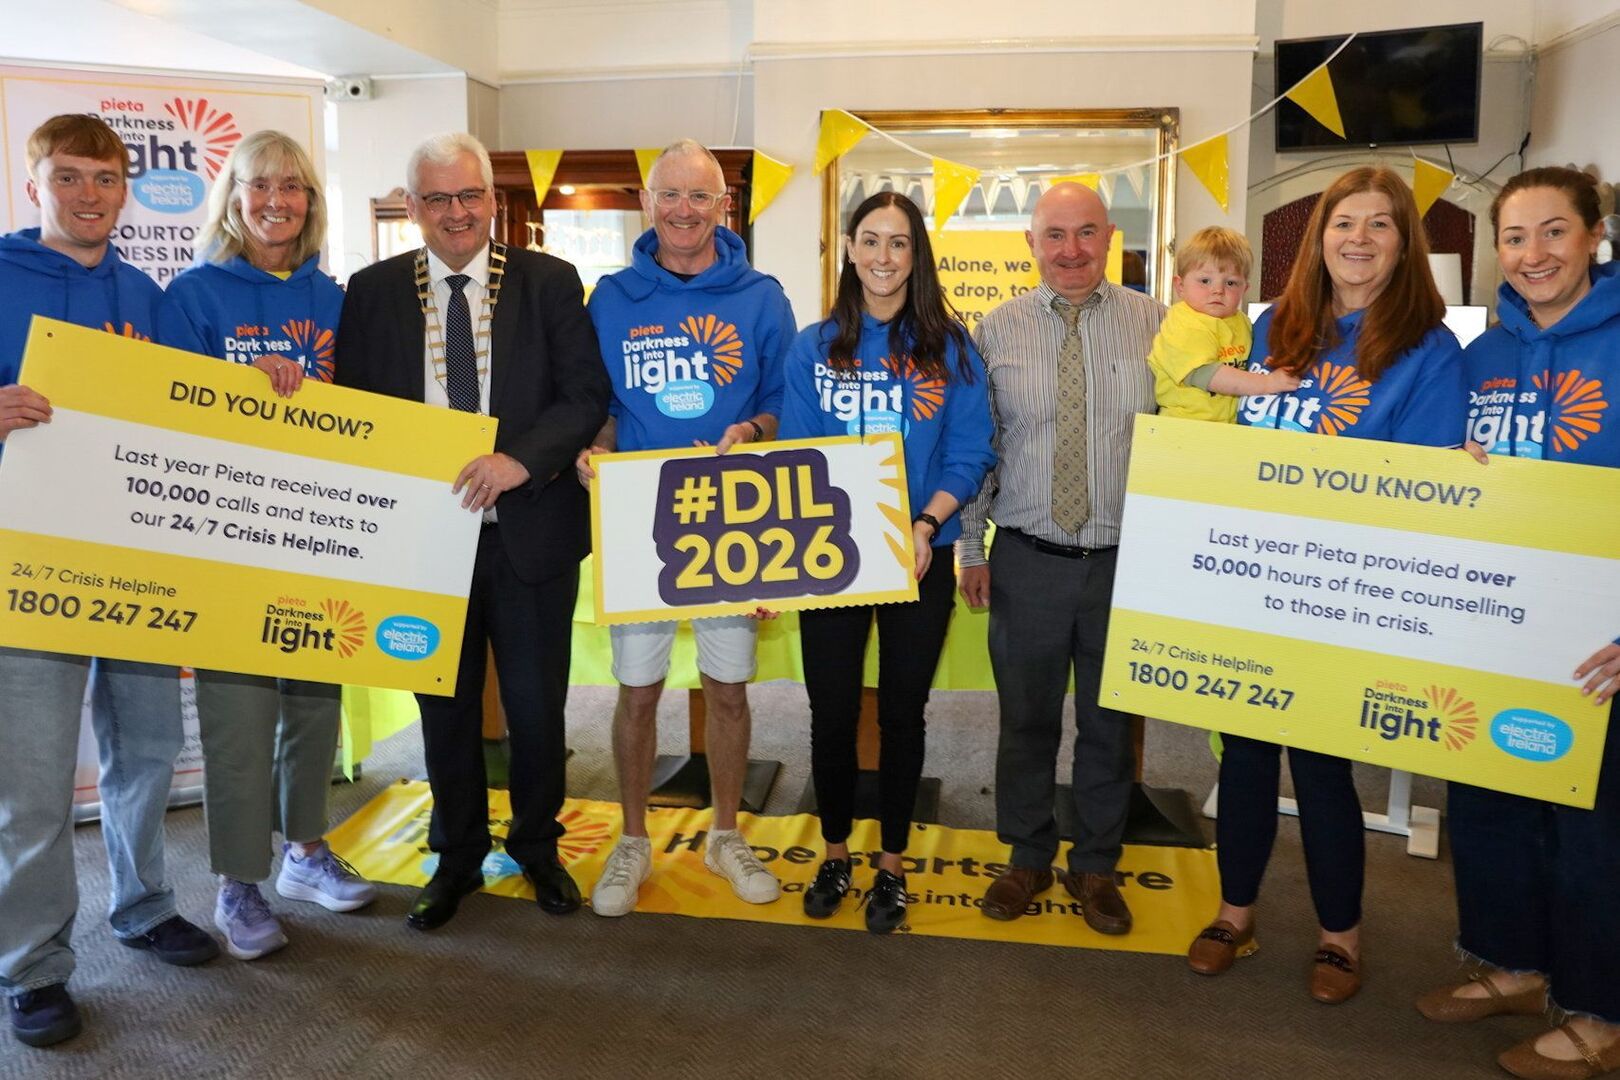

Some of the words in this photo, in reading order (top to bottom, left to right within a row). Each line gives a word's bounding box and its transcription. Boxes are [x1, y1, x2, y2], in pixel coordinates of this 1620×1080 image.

[101, 98, 144, 113] pieta
[119, 131, 145, 141] into
[126, 135, 197, 179] ght
[109, 225, 200, 241] COURTO
[116, 247, 168, 261] NESS
[938, 256, 997, 275] Alone,
[1005, 261, 1032, 272] we
[954, 282, 1003, 301] drop,
[630, 325, 664, 339] pieta
[622, 336, 690, 354] Darkness
[643, 350, 665, 361] into
[624, 350, 709, 394] light
[838, 381, 861, 390] into
[1481, 377, 1518, 391] pieta
[662, 391, 704, 404] electric
[670, 400, 705, 412] Ireland
[1469, 390, 1537, 406] Darknss
[170, 381, 217, 408] DID
[224, 392, 277, 421] YOU
[283, 405, 374, 440] KNOW?
[1240, 393, 1321, 428] ight
[1482, 405, 1504, 415] into
[854, 423, 897, 433] eectric
[1465, 406, 1546, 453] ight
[114, 444, 159, 468] Last
[164, 457, 210, 476] year
[215, 463, 266, 487] Pieta
[271, 477, 352, 502] received
[357, 493, 397, 509] over
[1258, 461, 1304, 485] DID
[1312, 467, 1368, 494] YOU
[1376, 475, 1482, 508] KNOW?
[672, 465, 834, 525] #DIL
[127, 476, 211, 506] 100,000
[216, 496, 260, 514] calls
[266, 505, 304, 522] and
[310, 510, 354, 530] texts
[360, 519, 378, 534] to
[131, 511, 166, 527] our
[170, 514, 219, 535] 24/7
[223, 523, 276, 545] Crisis
[282, 532, 363, 559] Helpline.
[673, 525, 845, 590] 2026
[1209, 528, 1249, 549] Last
[1255, 538, 1300, 555] year
[1304, 542, 1357, 565] Pieta
[1363, 553, 1460, 580] provided
[1466, 569, 1517, 588] over
[11, 562, 54, 581] 24/7
[58, 569, 104, 588] Crisis
[109, 576, 177, 598] Helpline
[1192, 554, 1262, 578] 50,000
[1267, 565, 1322, 588] hours
[1328, 577, 1349, 592] of
[1354, 579, 1395, 600] free
[1401, 589, 1526, 624] counselling
[7, 588, 81, 619] 1800
[88, 599, 142, 626] 247
[147, 606, 198, 633] 247
[277, 595, 306, 607] pieta
[266, 604, 324, 621] Darkness
[1264, 595, 1284, 611] to
[1291, 598, 1347, 621] those
[1352, 607, 1370, 625] in
[1376, 614, 1434, 636] crisis.
[285, 618, 303, 628] into
[261, 616, 336, 654] light
[383, 628, 428, 643] electric
[389, 639, 427, 654] Ireland
[1131, 638, 1165, 656] 24/7
[1168, 645, 1208, 664] Crisis
[1211, 653, 1274, 676] Helpline
[1128, 661, 1188, 691] 1800
[1195, 674, 1241, 701] 247
[1247, 684, 1295, 711] 247
[1375, 679, 1408, 693] pieta
[1364, 687, 1428, 709] Darkness
[1385, 703, 1405, 714] into
[1360, 700, 1442, 742] light
[1500, 723, 1556, 744] electric
[1508, 735, 1556, 755] Ireland
[664, 830, 816, 864] Hpe
[1023, 899, 1084, 916] ght
